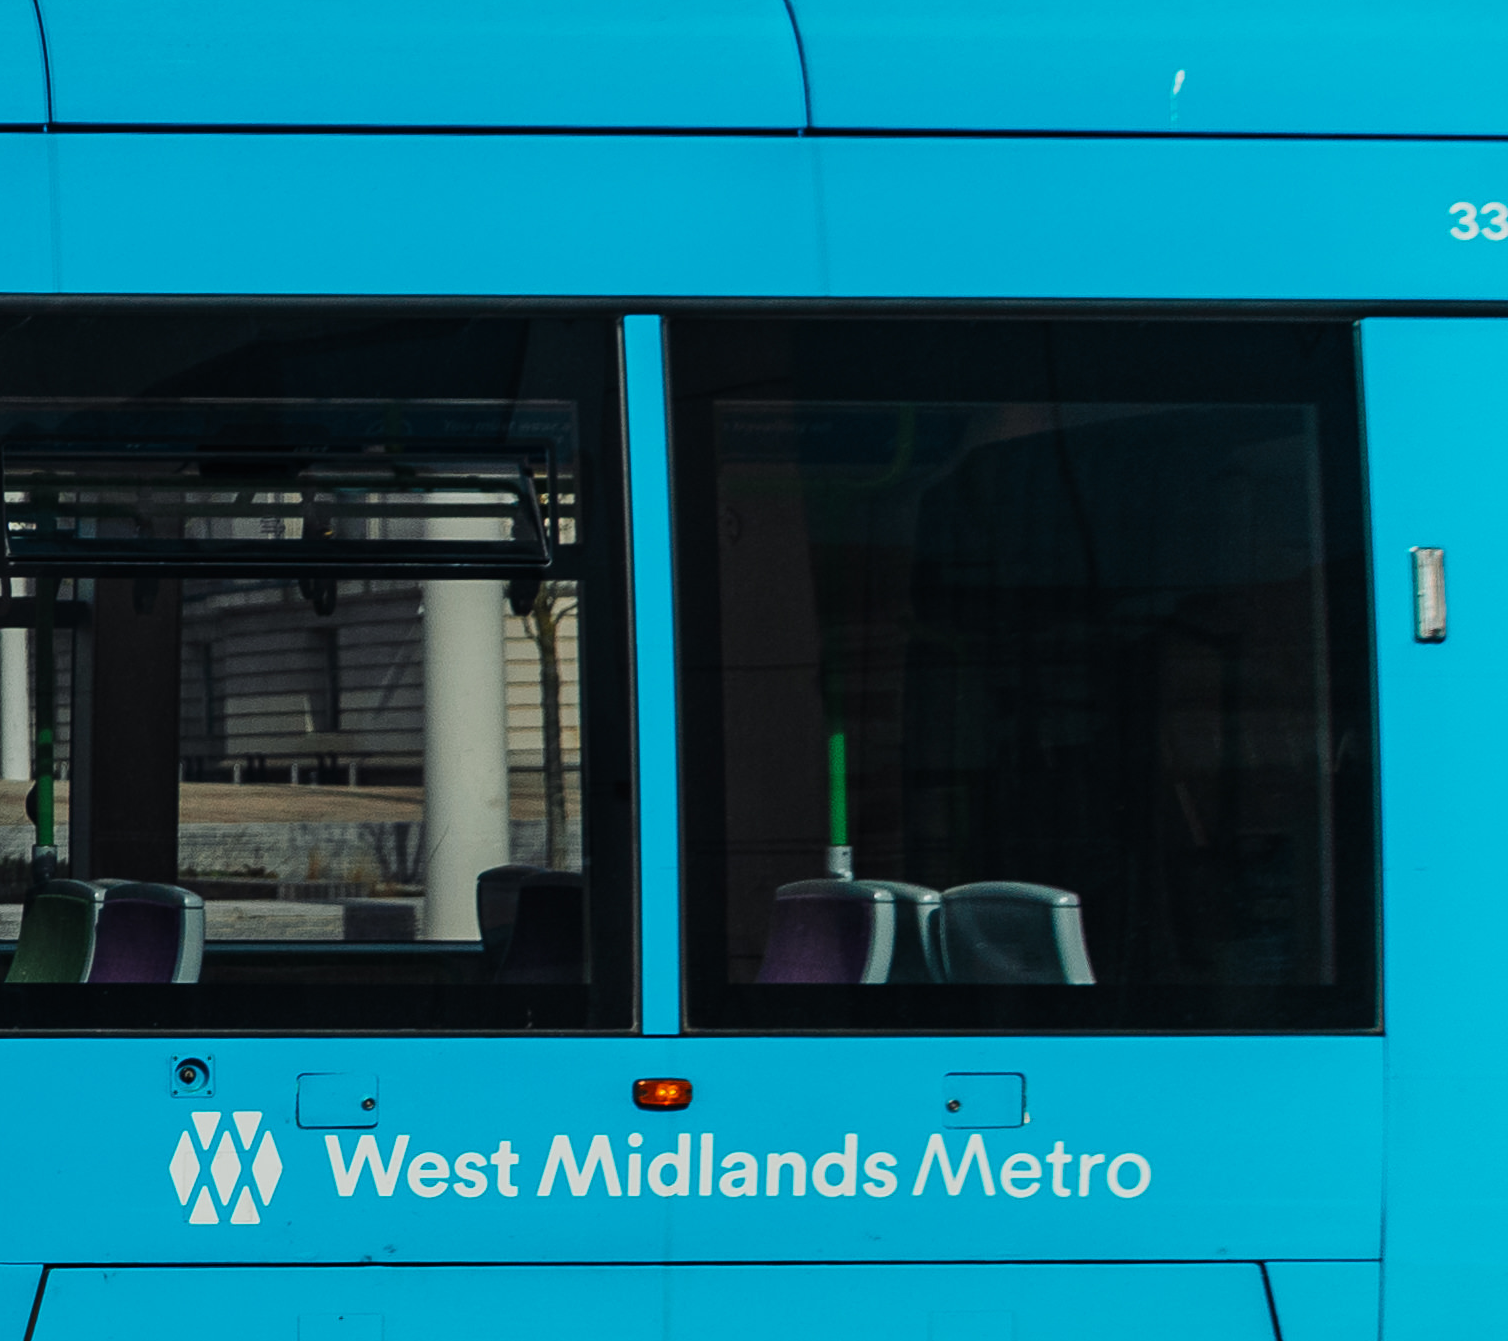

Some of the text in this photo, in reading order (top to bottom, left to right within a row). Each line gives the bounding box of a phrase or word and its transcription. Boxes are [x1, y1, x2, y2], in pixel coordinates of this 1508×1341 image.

[1449, 201, 1508, 241] 33
[325, 1133, 1152, 1198] West Midlands Metro
